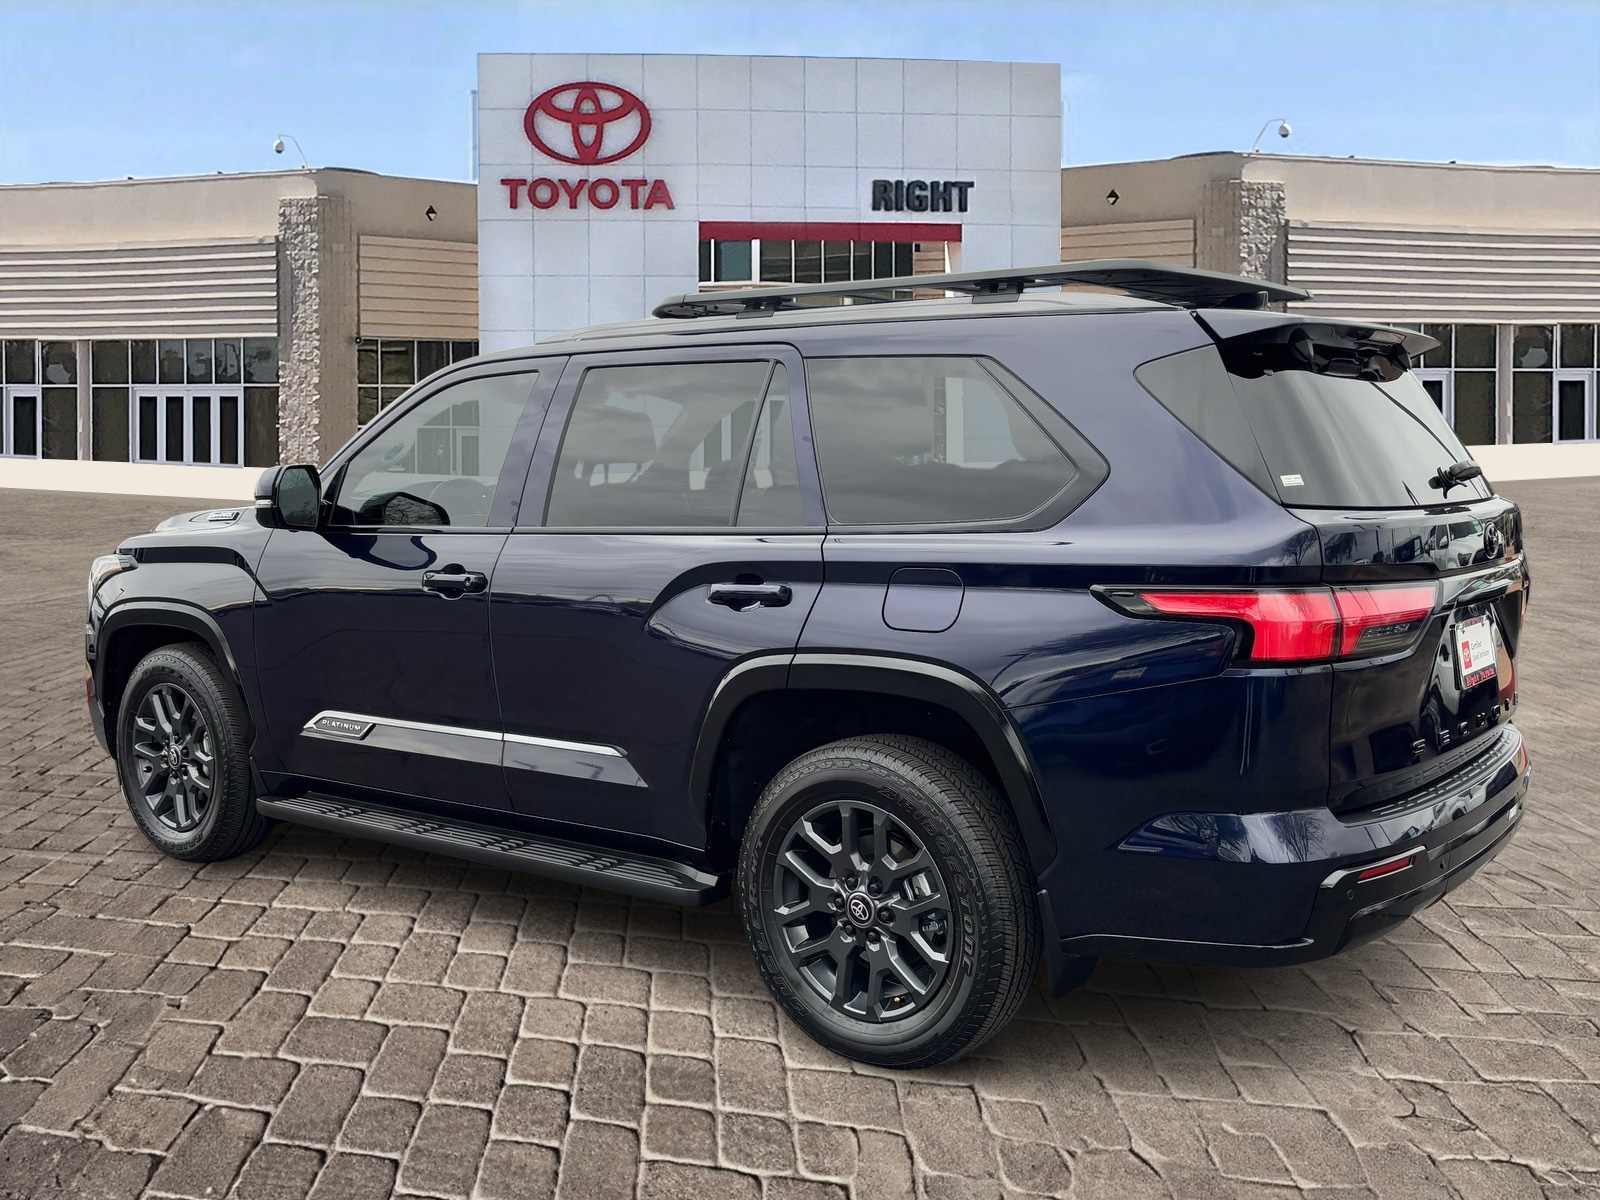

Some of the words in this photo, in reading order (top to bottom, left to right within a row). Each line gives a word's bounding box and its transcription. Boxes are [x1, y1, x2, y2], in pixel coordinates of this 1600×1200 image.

[501, 179, 674, 210] TOYOTA
[872, 180, 975, 212] RIGHT
[321, 719, 361, 732] PLATINUM
[878, 785, 976, 978] BRIDGESTONE
